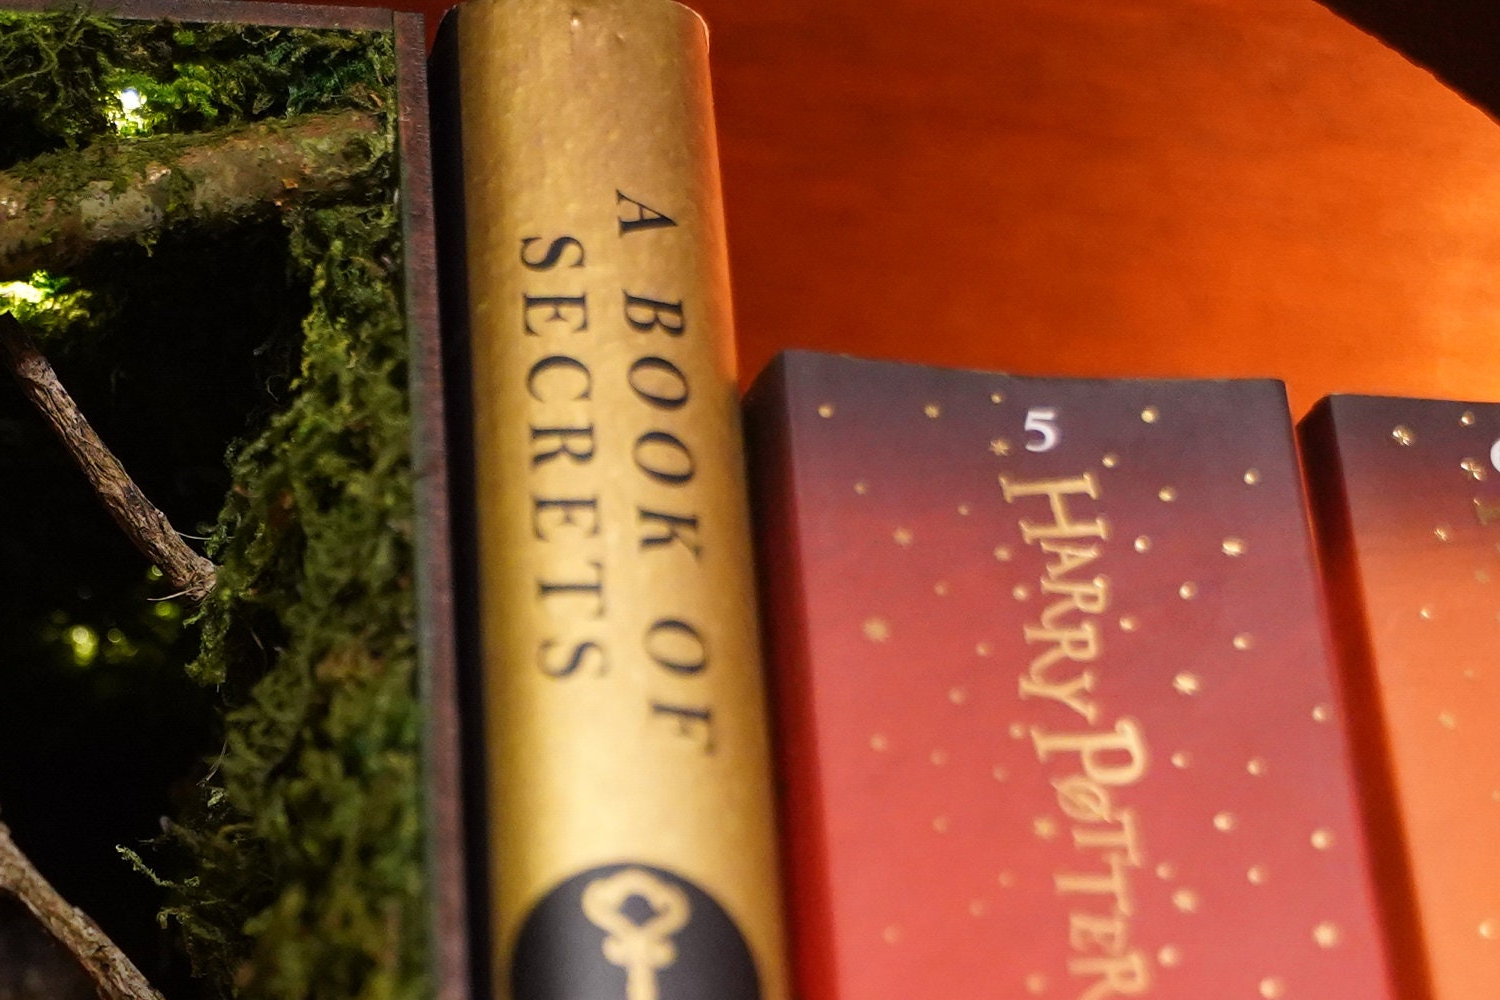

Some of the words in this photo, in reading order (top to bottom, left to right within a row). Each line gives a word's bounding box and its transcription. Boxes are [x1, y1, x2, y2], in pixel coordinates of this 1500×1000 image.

[615, 187, 678, 236] A
[518, 233, 610, 679] SECRETS
[623, 288, 700, 562] BOOK
[1023, 408, 1060, 454] 5
[642, 616, 716, 756] OF
[999, 472, 1111, 723] HARRY
